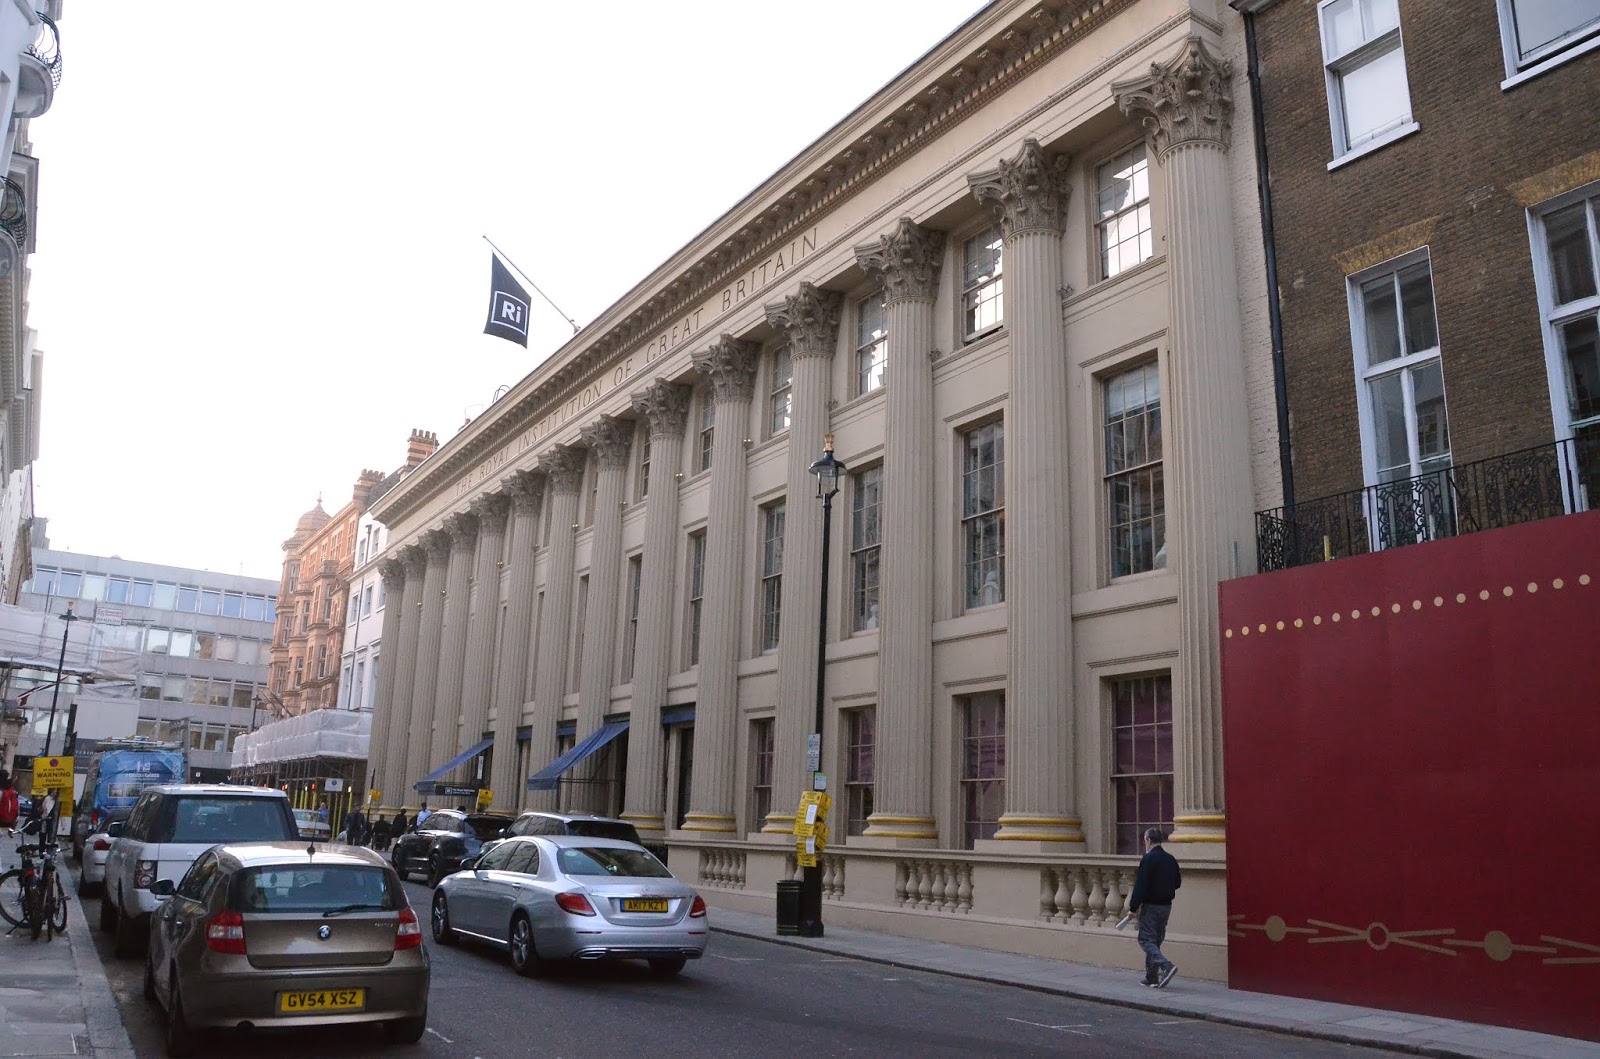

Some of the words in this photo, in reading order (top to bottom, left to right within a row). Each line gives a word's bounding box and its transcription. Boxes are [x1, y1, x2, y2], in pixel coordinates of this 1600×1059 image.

[501, 300, 522, 324] Ri
[614, 358, 633, 386] OF
[646, 307, 704, 364] GREAT
[721, 227, 817, 313] BRITAIN
[628, 900, 647, 910] AK17
[649, 899, 665, 910] KZT
[288, 994, 326, 1008] GV54
[330, 992, 357, 1005] XSZ
